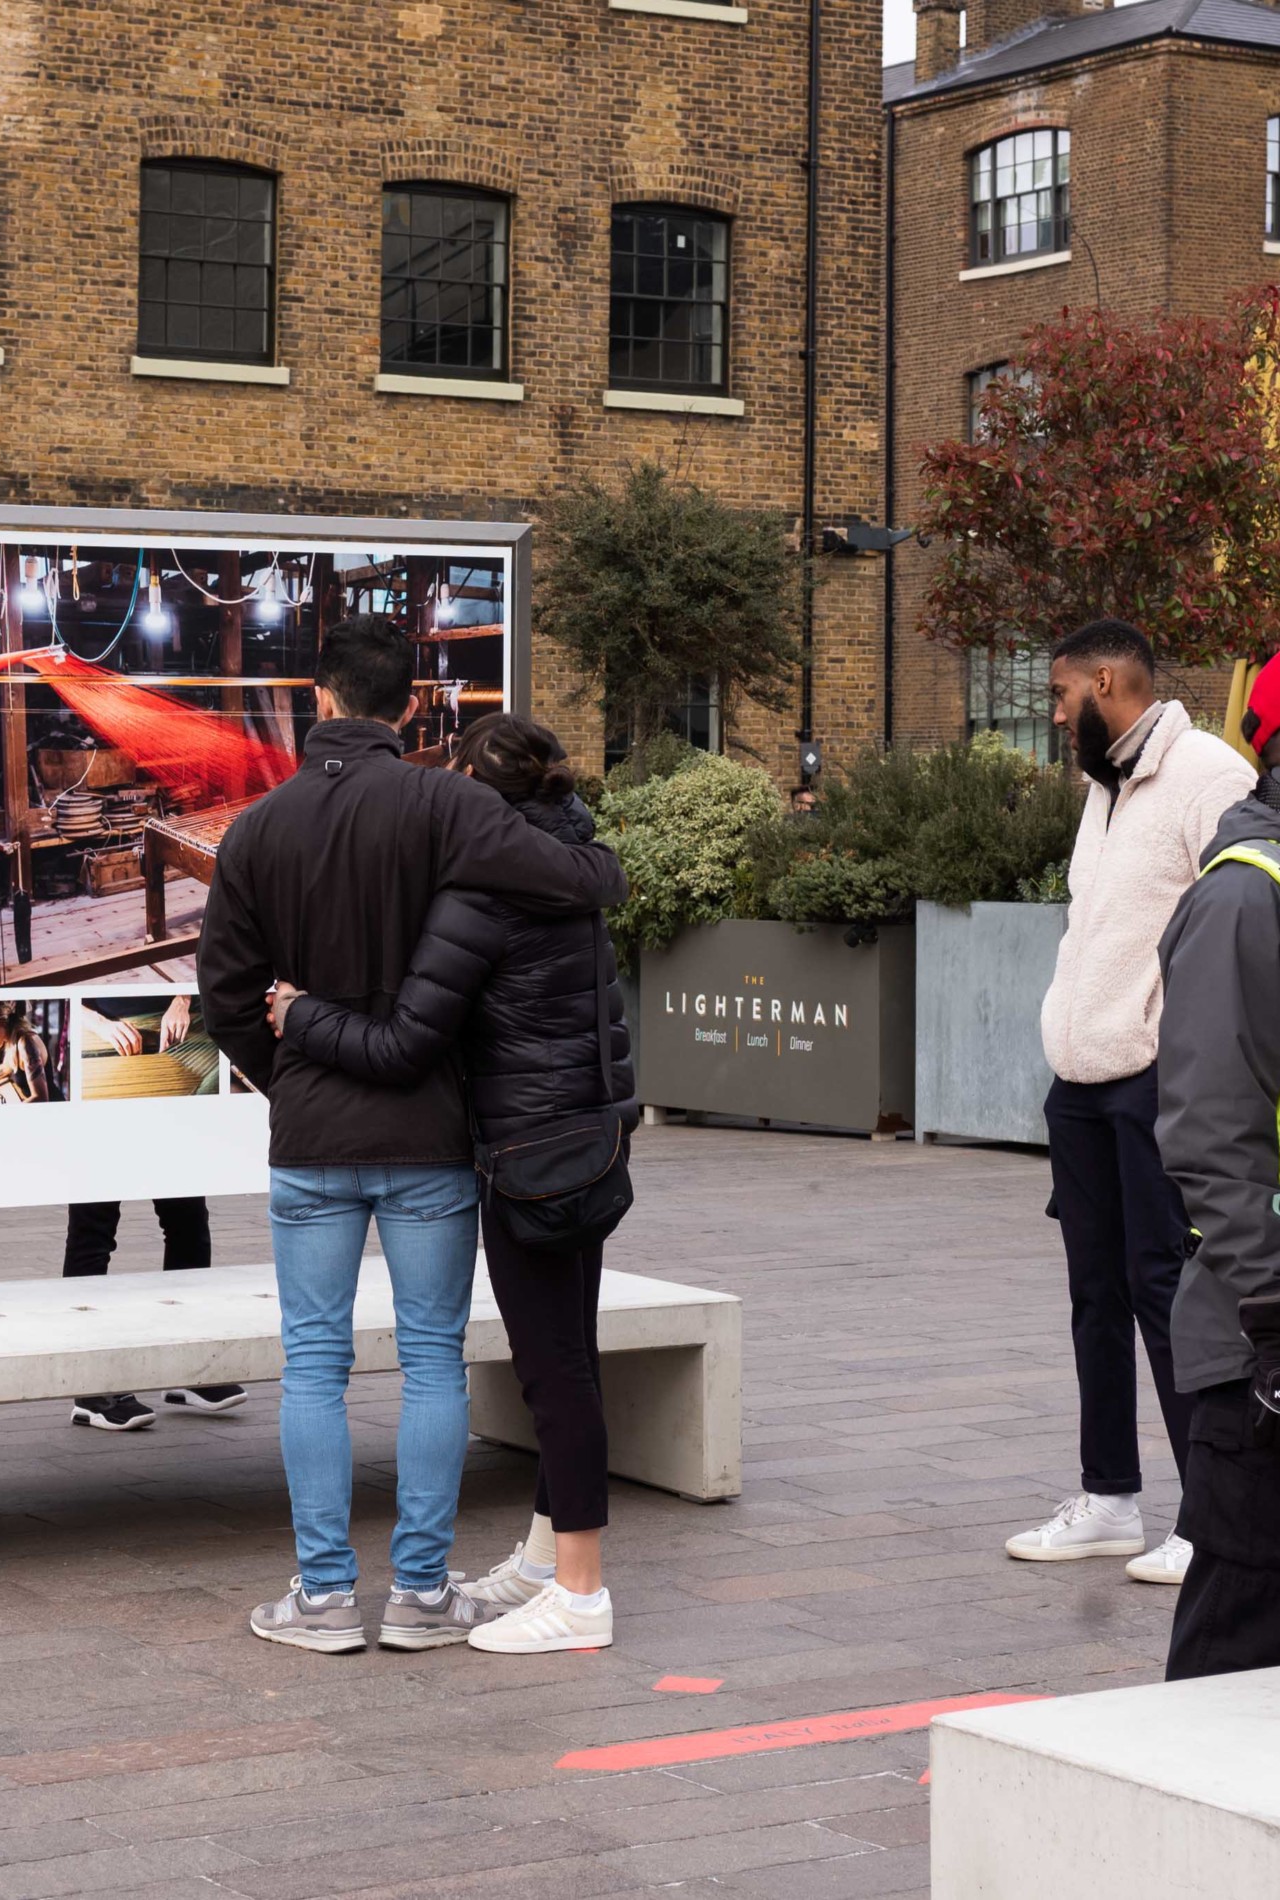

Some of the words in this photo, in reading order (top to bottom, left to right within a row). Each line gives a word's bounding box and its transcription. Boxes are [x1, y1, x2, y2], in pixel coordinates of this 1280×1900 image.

[743, 974, 765, 985] THE
[665, 991, 849, 1028] LIGHTERMAN
[695, 1027, 727, 1045] Breakfast
[746, 1033, 769, 1048] Lunch
[789, 1036, 814, 1052] Dinner
